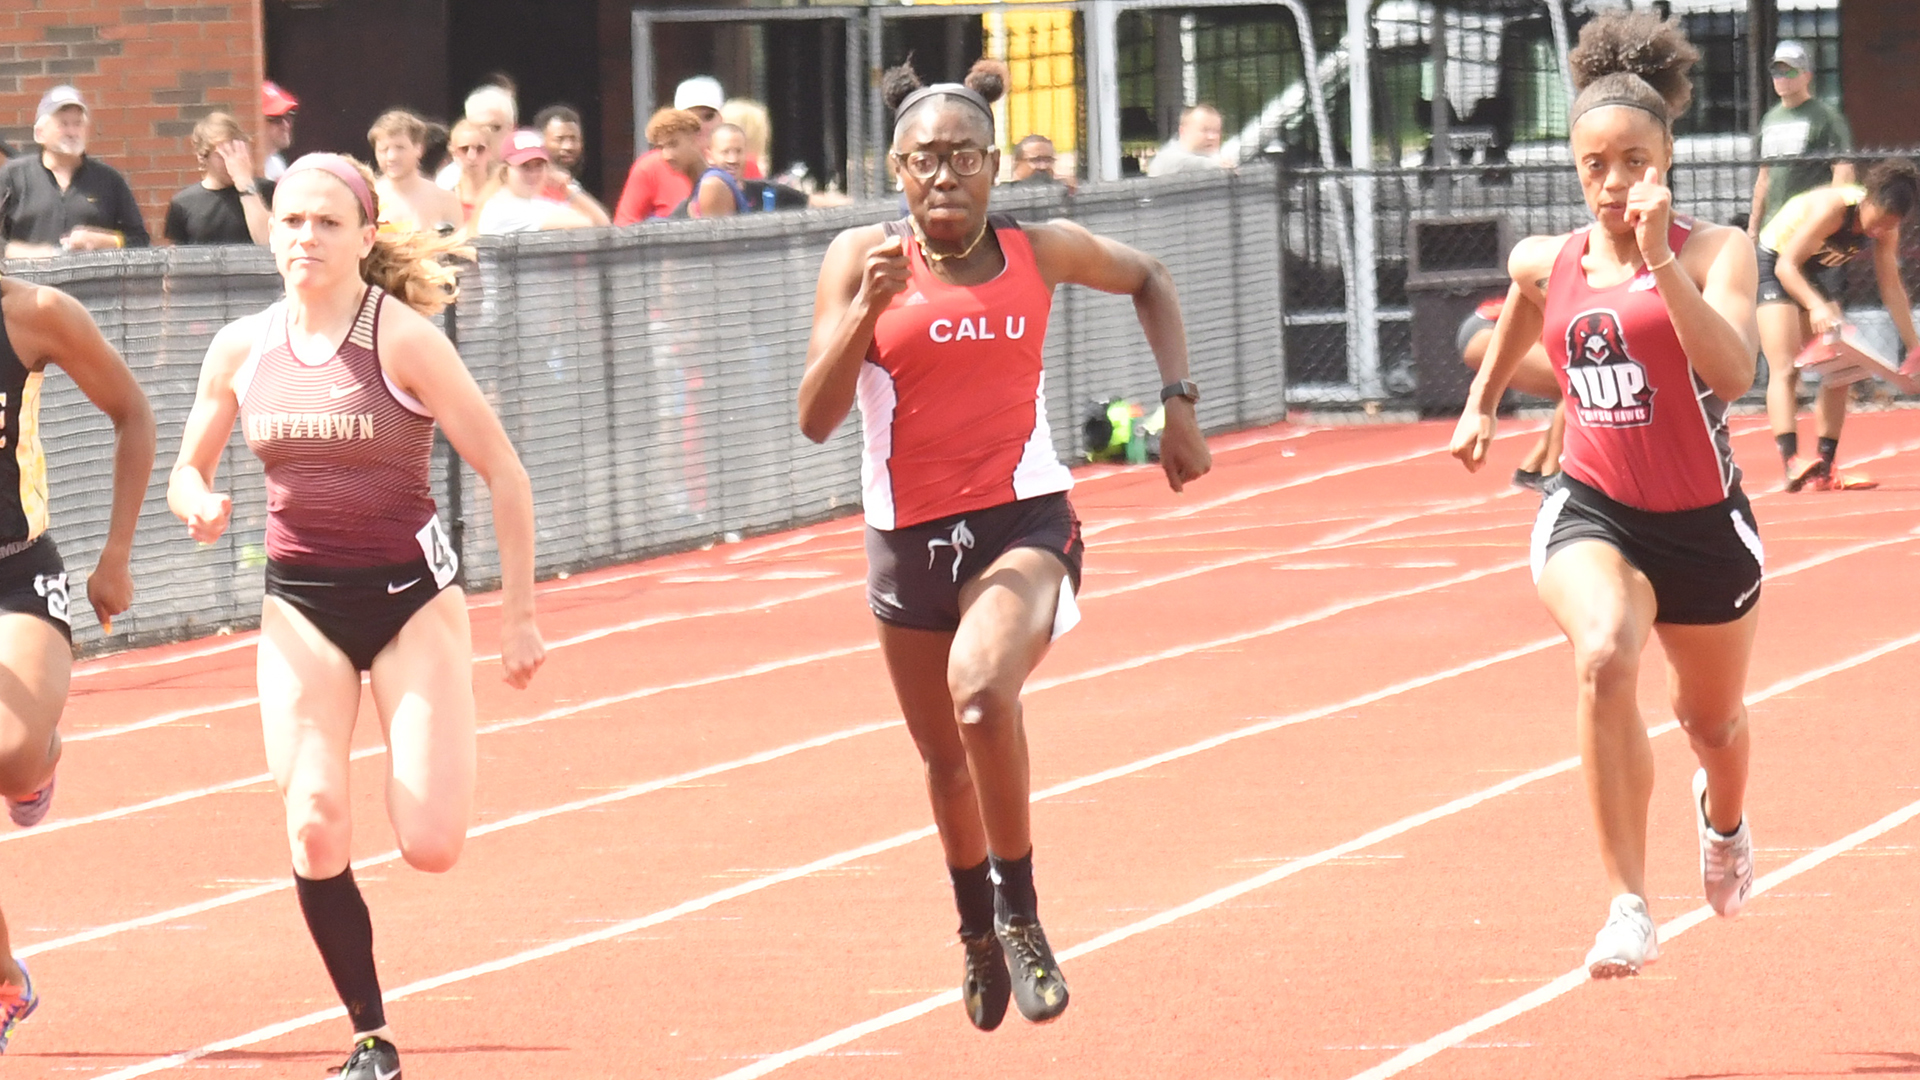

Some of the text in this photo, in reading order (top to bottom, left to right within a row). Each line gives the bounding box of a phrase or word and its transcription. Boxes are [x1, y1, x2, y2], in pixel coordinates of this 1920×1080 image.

[929, 315, 1025, 343] CAL U
[1566, 363, 1645, 409] IUP
[249, 413, 374, 441] KUTZTOWN
[430, 524, 454, 573] 4
